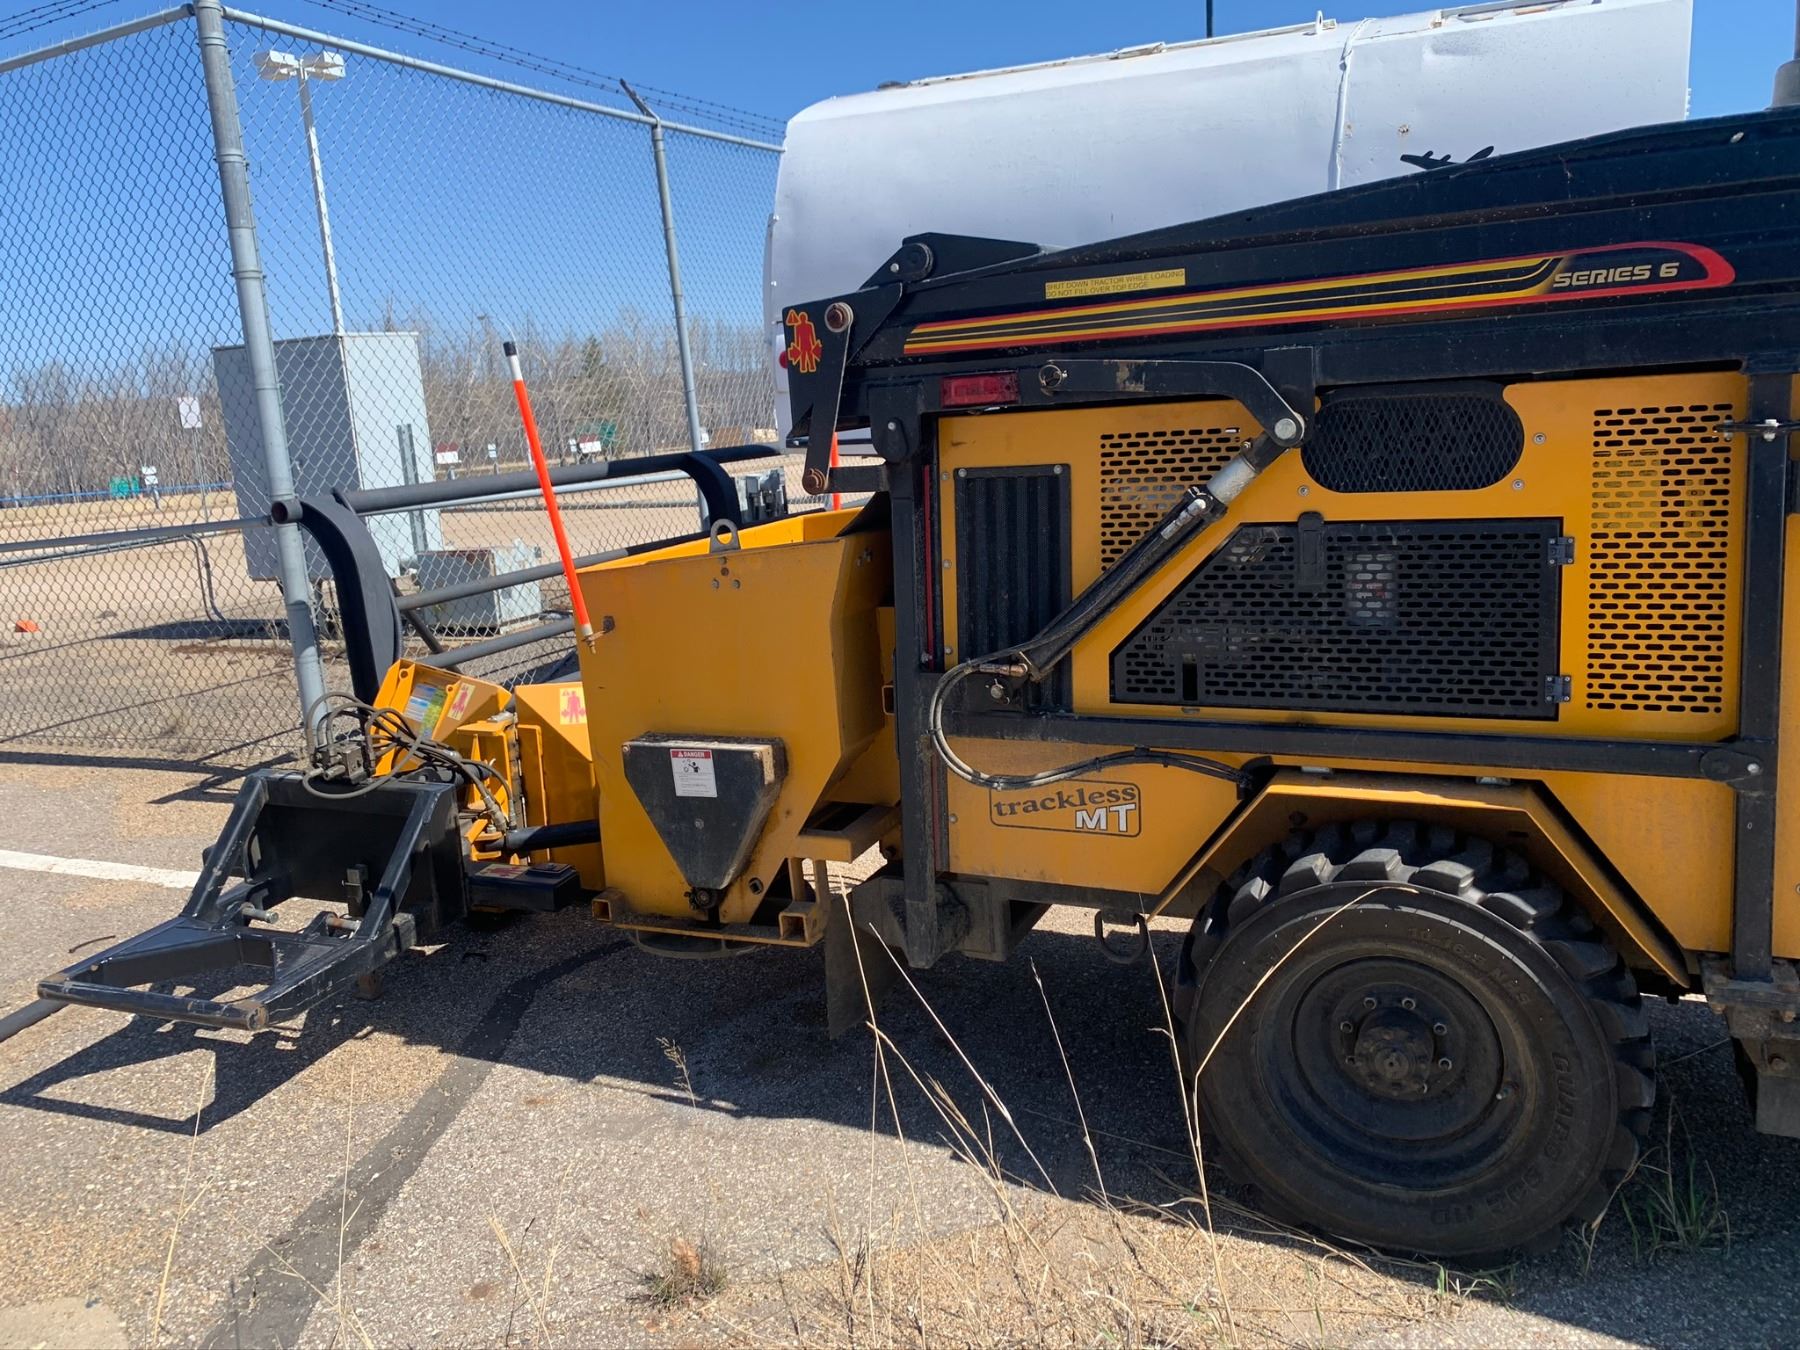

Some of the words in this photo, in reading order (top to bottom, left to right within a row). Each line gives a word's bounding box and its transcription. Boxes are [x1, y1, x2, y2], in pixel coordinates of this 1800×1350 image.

[1047, 283, 1064, 291] SHUT
[1066, 281, 1089, 289] DOWN
[1090, 278, 1125, 287] TRACTOR
[1126, 275, 1147, 283] WHILE
[1150, 271, 1184, 280] LOADING
[1553, 264, 1652, 288] SERIES
[1659, 262, 1680, 278] 6
[1047, 290, 1057, 298] DO
[1058, 289, 1072, 297] NOT
[1090, 286, 1111, 294] OVER
[1112, 284, 1127, 292] TOP
[1128, 282, 1148, 290] EDGE
[993, 786, 1137, 817] trackless
[1075, 803, 1136, 832] MT
